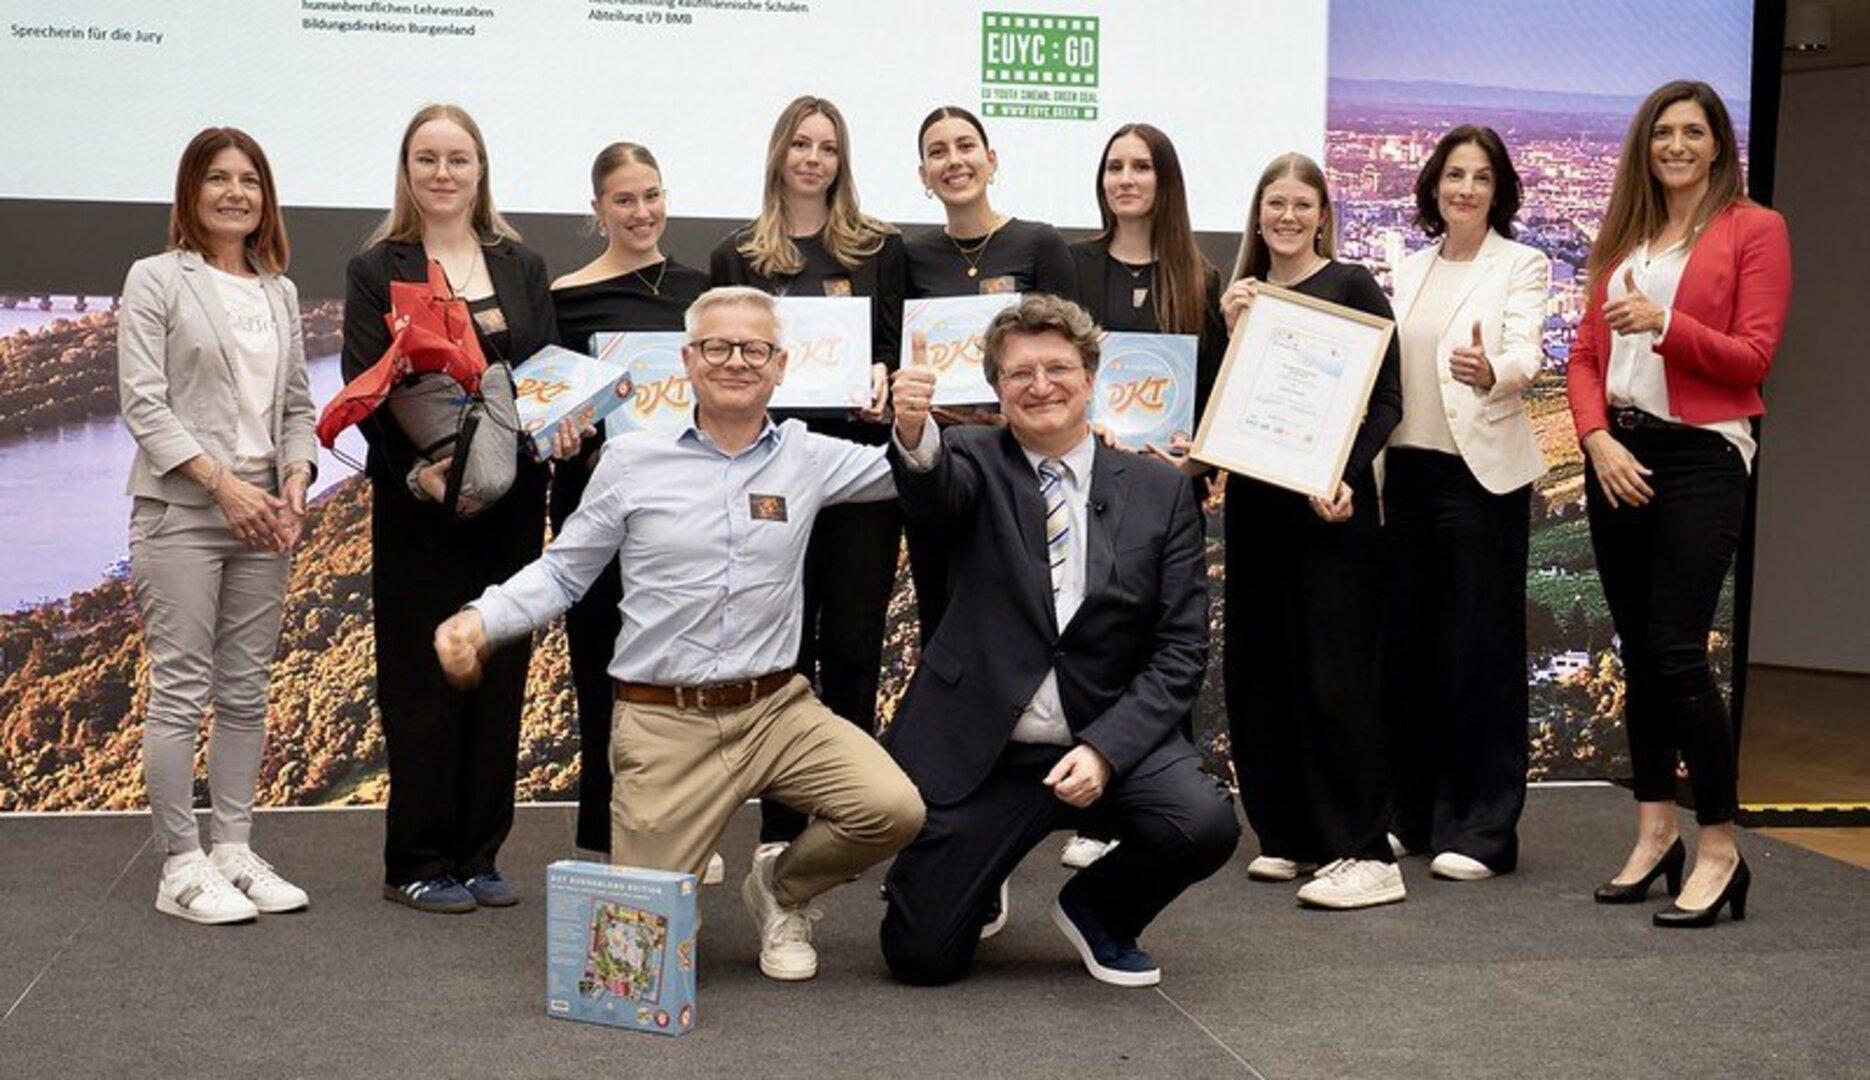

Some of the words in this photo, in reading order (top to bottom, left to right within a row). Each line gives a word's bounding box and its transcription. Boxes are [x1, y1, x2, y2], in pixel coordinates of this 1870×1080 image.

[414, 4, 494, 18] Lehranstalten
[765, 1, 809, 13] Schulen
[588, 9, 643, 24] Abteilung
[666, 12, 693, 25] BMB
[10, 23, 85, 39] Sprecherin
[88, 27, 108, 40] für
[111, 28, 132, 41] die
[135, 30, 164, 44] Jury
[302, 18, 405, 33] Bildungsdirektion
[408, 23, 476, 36] Burgenland
[987, 32, 1046, 66] EUYC
[1065, 35, 1095, 68] GD
[1107, 376, 1171, 413] DKT
